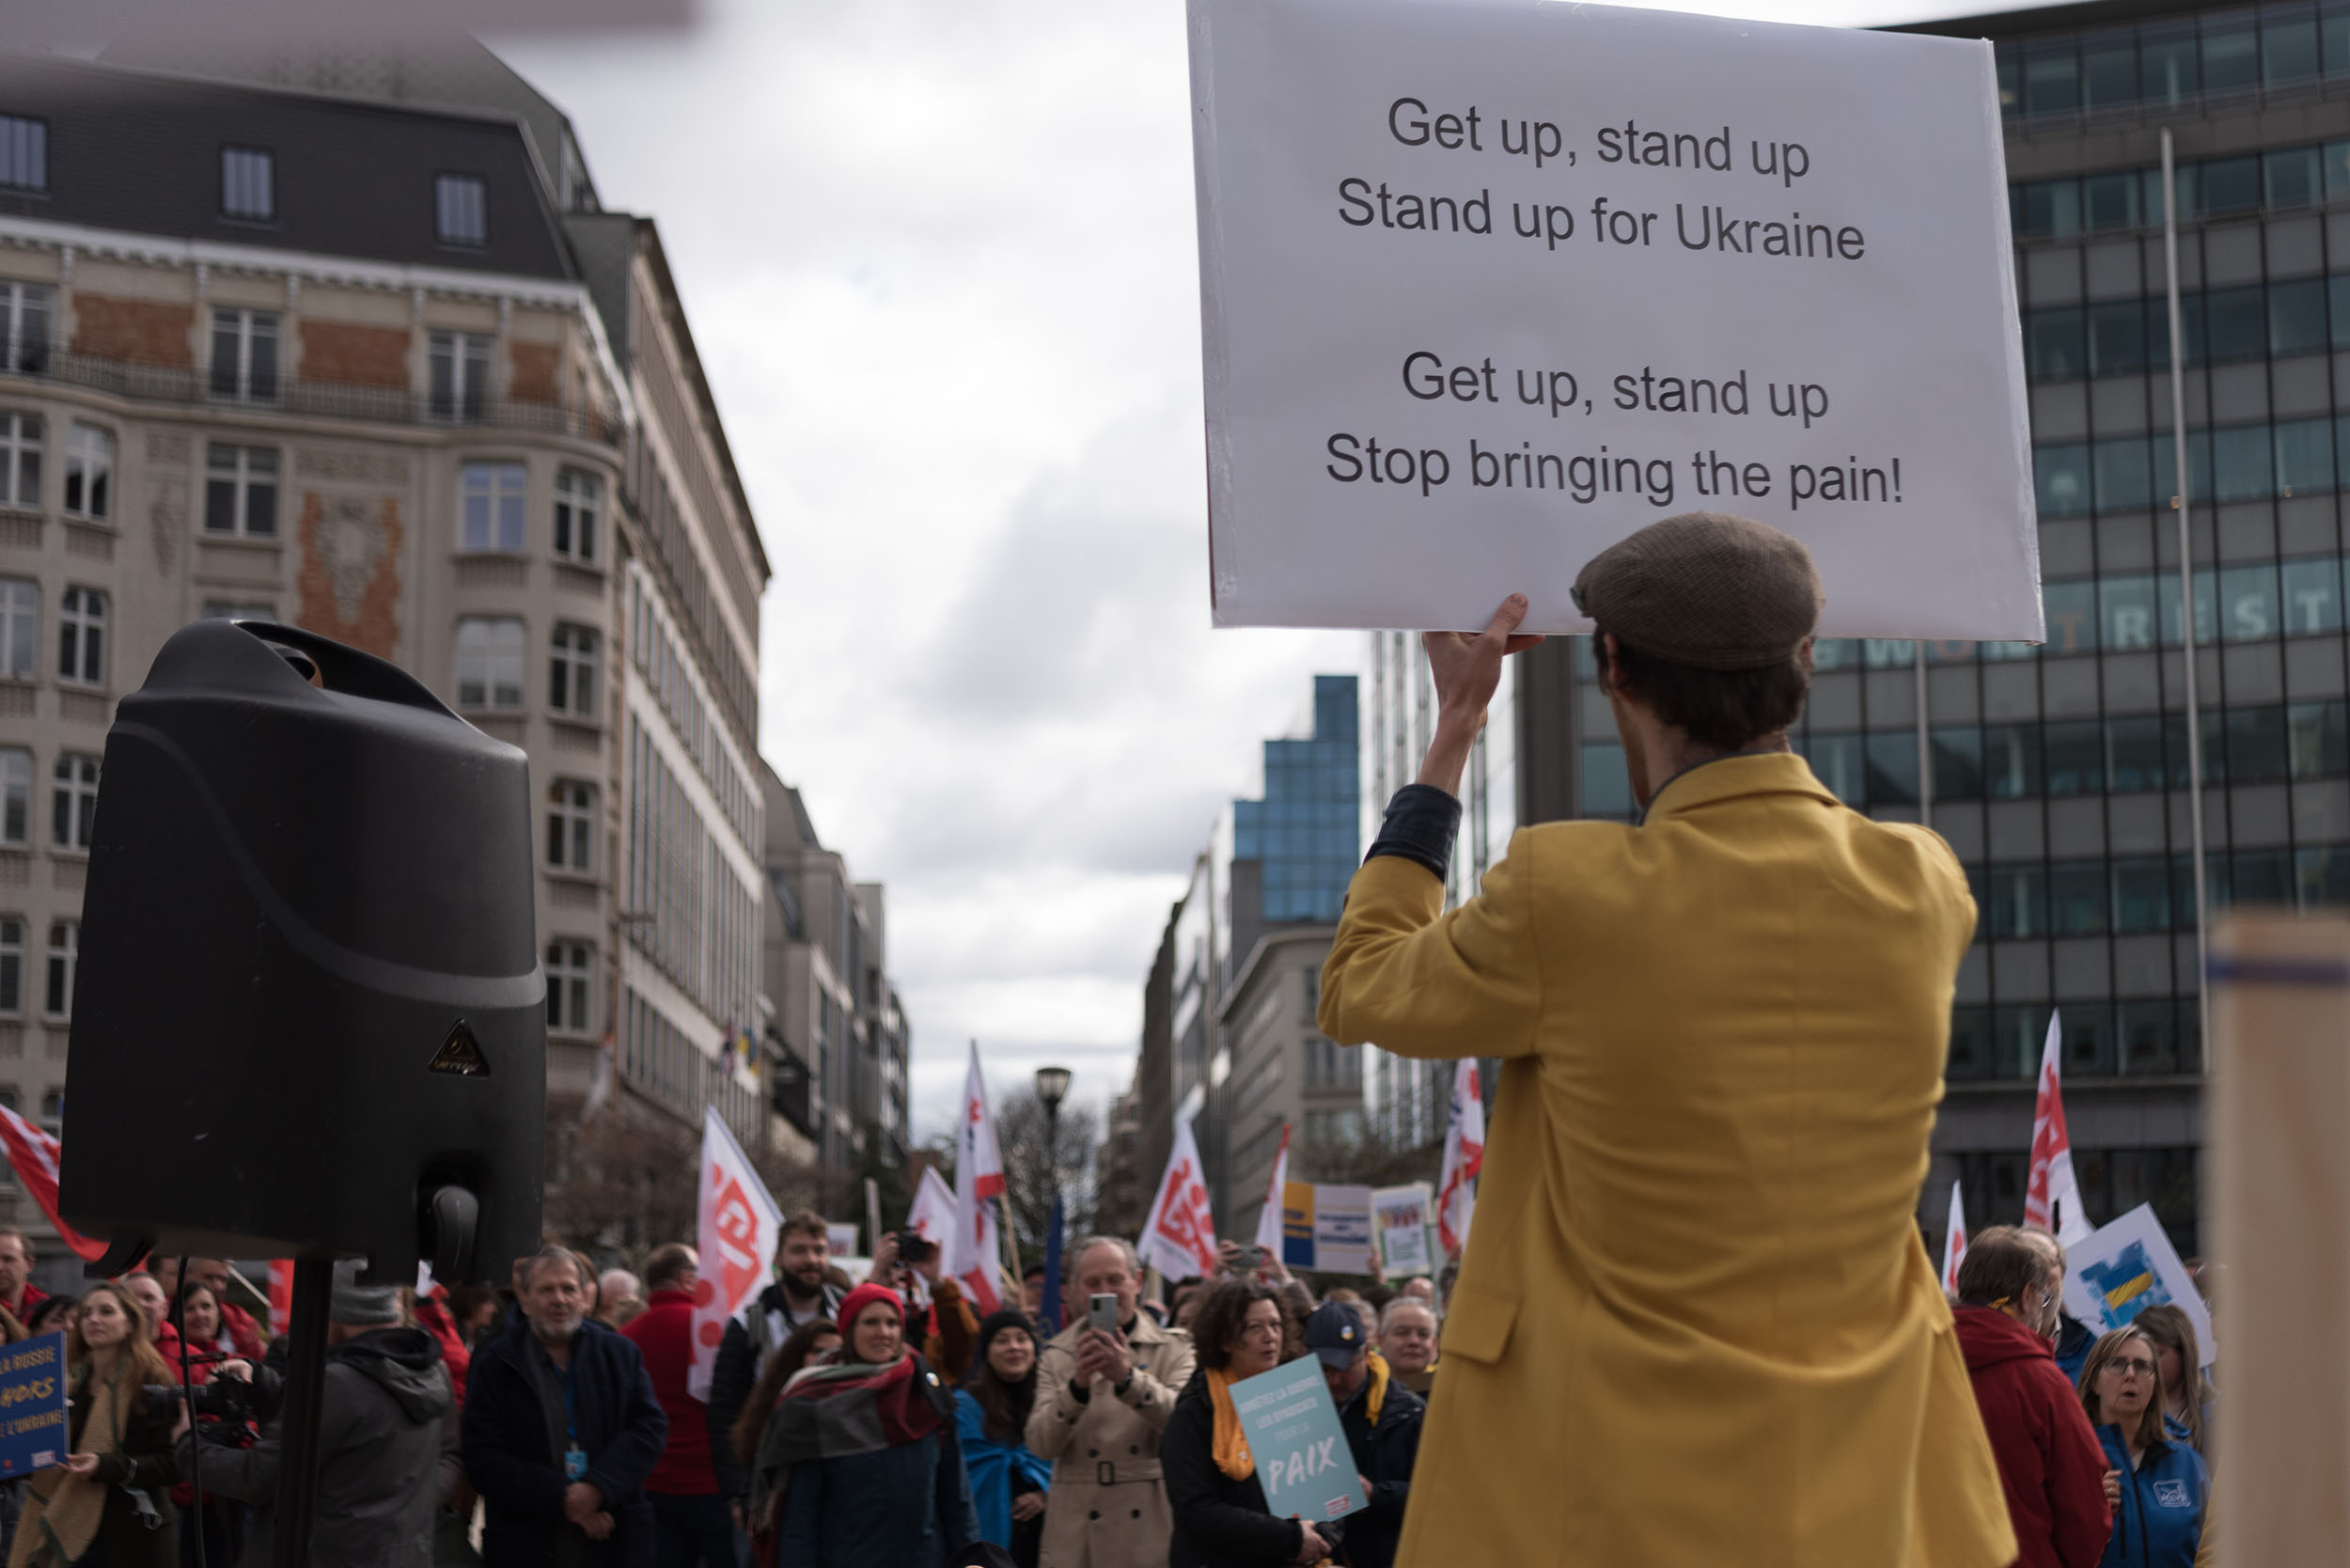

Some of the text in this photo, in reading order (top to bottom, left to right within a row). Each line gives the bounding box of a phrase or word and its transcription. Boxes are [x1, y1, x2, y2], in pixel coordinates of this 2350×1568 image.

[1387, 97, 1810, 189] Get up, stand up
[1338, 177, 1866, 260] Stand up for Ukraine
[1402, 351, 1829, 430] Get up, stand up
[1325, 432, 1904, 511] Stop bringing the pain!
[1268, 1435, 1339, 1496] PAIX
